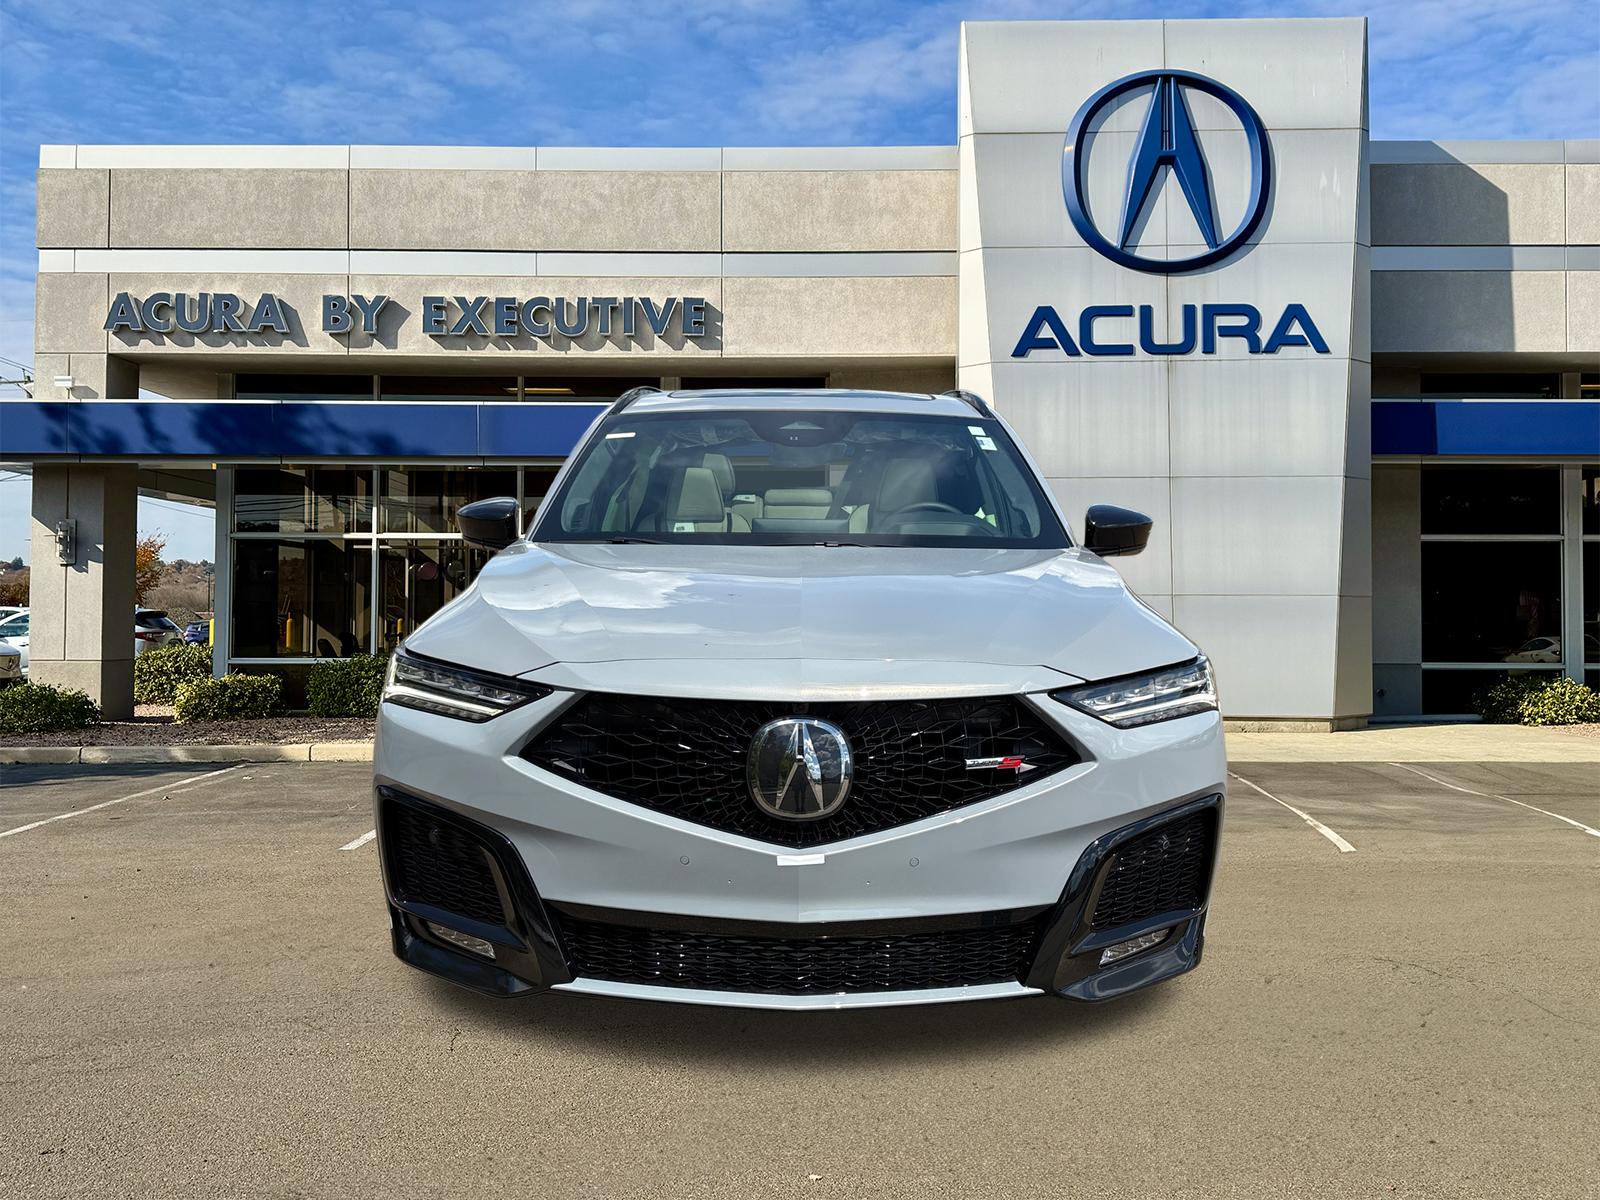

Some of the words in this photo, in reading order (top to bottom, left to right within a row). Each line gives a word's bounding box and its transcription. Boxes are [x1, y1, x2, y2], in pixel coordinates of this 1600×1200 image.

[103, 292, 290, 333] ACURA
[322, 294, 390, 334] BY
[422, 296, 706, 337] EXECUTIVE
[1010, 303, 1332, 358] ACURA
